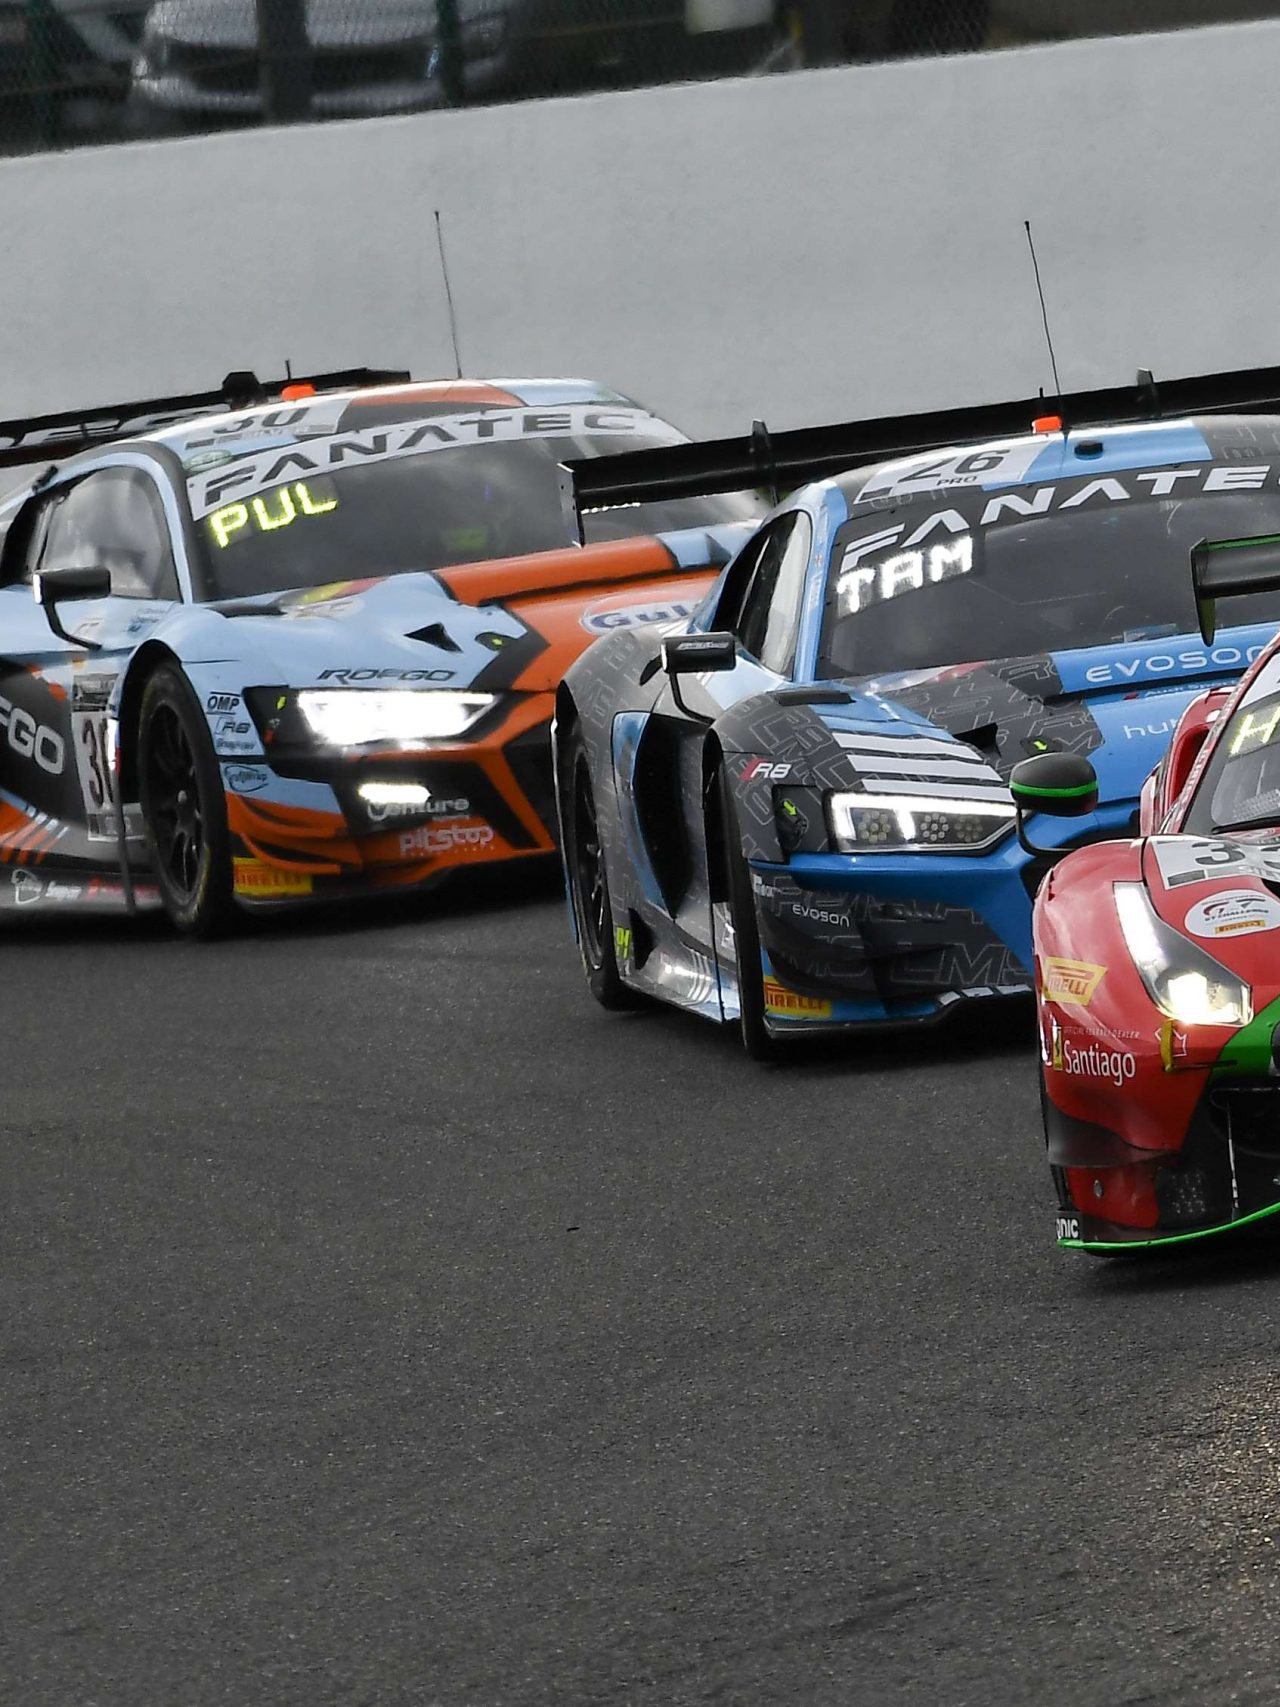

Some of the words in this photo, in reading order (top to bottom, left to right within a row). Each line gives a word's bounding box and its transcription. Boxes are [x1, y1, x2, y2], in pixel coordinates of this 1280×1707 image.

[204, 413, 636, 507] FANATEC
[898, 448, 1010, 485] 26
[936, 475, 978, 486] PRO
[209, 483, 338, 548] PUL
[836, 535, 974, 613] TAM
[590, 604, 690, 629] Gul
[317, 668, 458, 685] ROFGO
[207, 695, 240, 711] OMP
[751, 762, 793, 779] R8
[1063, 1039, 1136, 1087] Santiago
